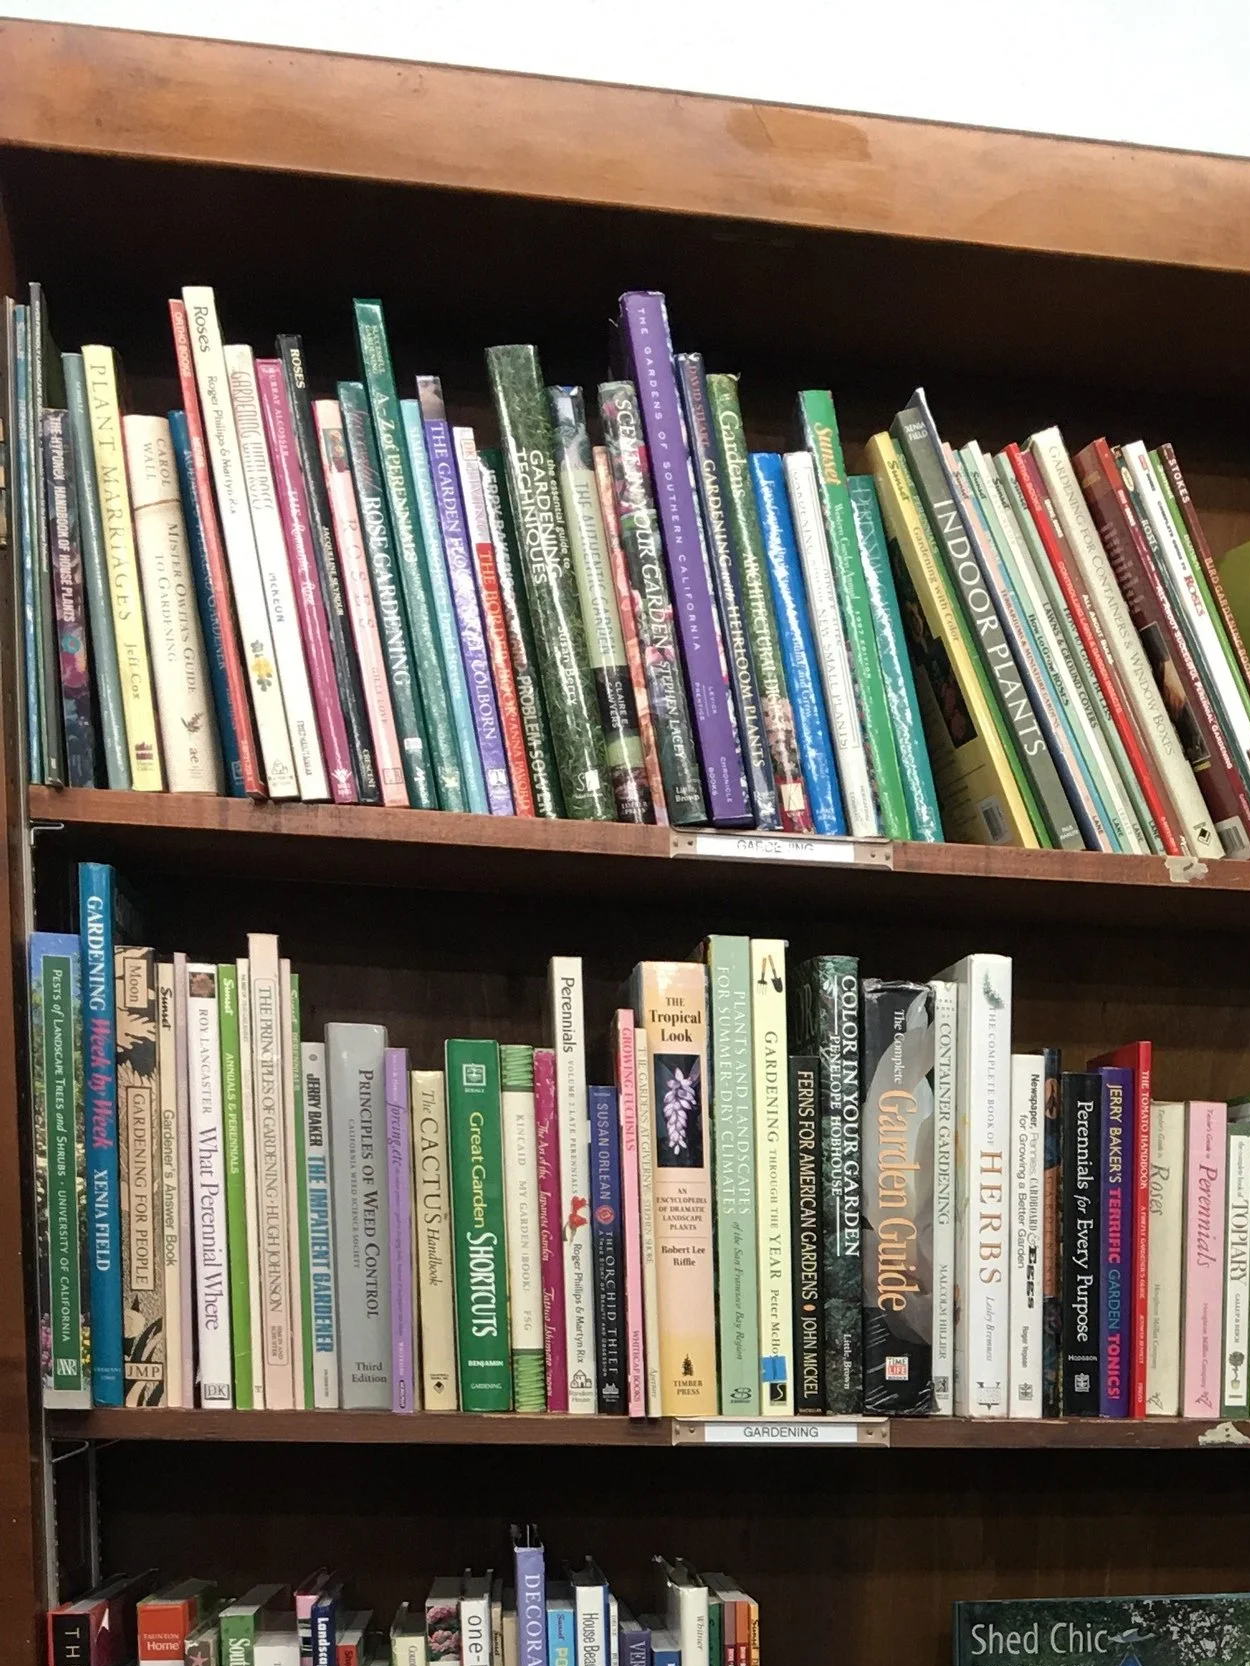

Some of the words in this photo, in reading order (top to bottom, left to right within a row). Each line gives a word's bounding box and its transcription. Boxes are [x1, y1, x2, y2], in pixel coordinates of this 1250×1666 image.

[193, 305, 210, 353] Roses
[637, 307, 647, 334] THE
[644, 346, 663, 421] GARDENS
[658, 431, 668, 451] OF
[90, 364, 113, 448] PLANT
[102, 464, 131, 621] MARRIAGES
[662, 461, 683, 544] SOUTHERN
[678, 554, 700, 651] CALIFORNIA
[933, 500, 999, 637] INDOOR
[989, 641, 1046, 757] PLANTS
[127, 963, 140, 1003] Moon
[666, 997, 684, 1007] THE
[560, 976, 575, 1053] Perennials
[648, 1010, 701, 1026] Tropical
[660, 1028, 693, 1043] Look
[132, 1093, 146, 1188] GARDENING
[201, 1126, 217, 1179] What
[470, 1112, 484, 1162] Great
[879, 1090, 920, 1208] Garden
[1076, 1100, 1094, 1190] Perennials
[135, 1194, 146, 1231] FOR
[202, 1181, 222, 1271] Perennial
[472, 1165, 486, 1229] Garden
[979, 1150, 1004, 1284] HERBS
[1075, 1195, 1091, 1211] for
[135, 1234, 148, 1285] PEOPLE
[878, 1215, 919, 1310] Guide
[1073, 1214, 1094, 1269] Every
[1230, 1199, 1249, 1287] TOPIARY
[205, 1273, 224, 1330] Where
[467, 1231, 498, 1338] SHORTCUTS
[1072, 1275, 1093, 1344] Purpose
[743, 1426, 819, 1438] GARDENING
[971, 1623, 1039, 1655] Shed
[1050, 1622, 1108, 1654] Chic
